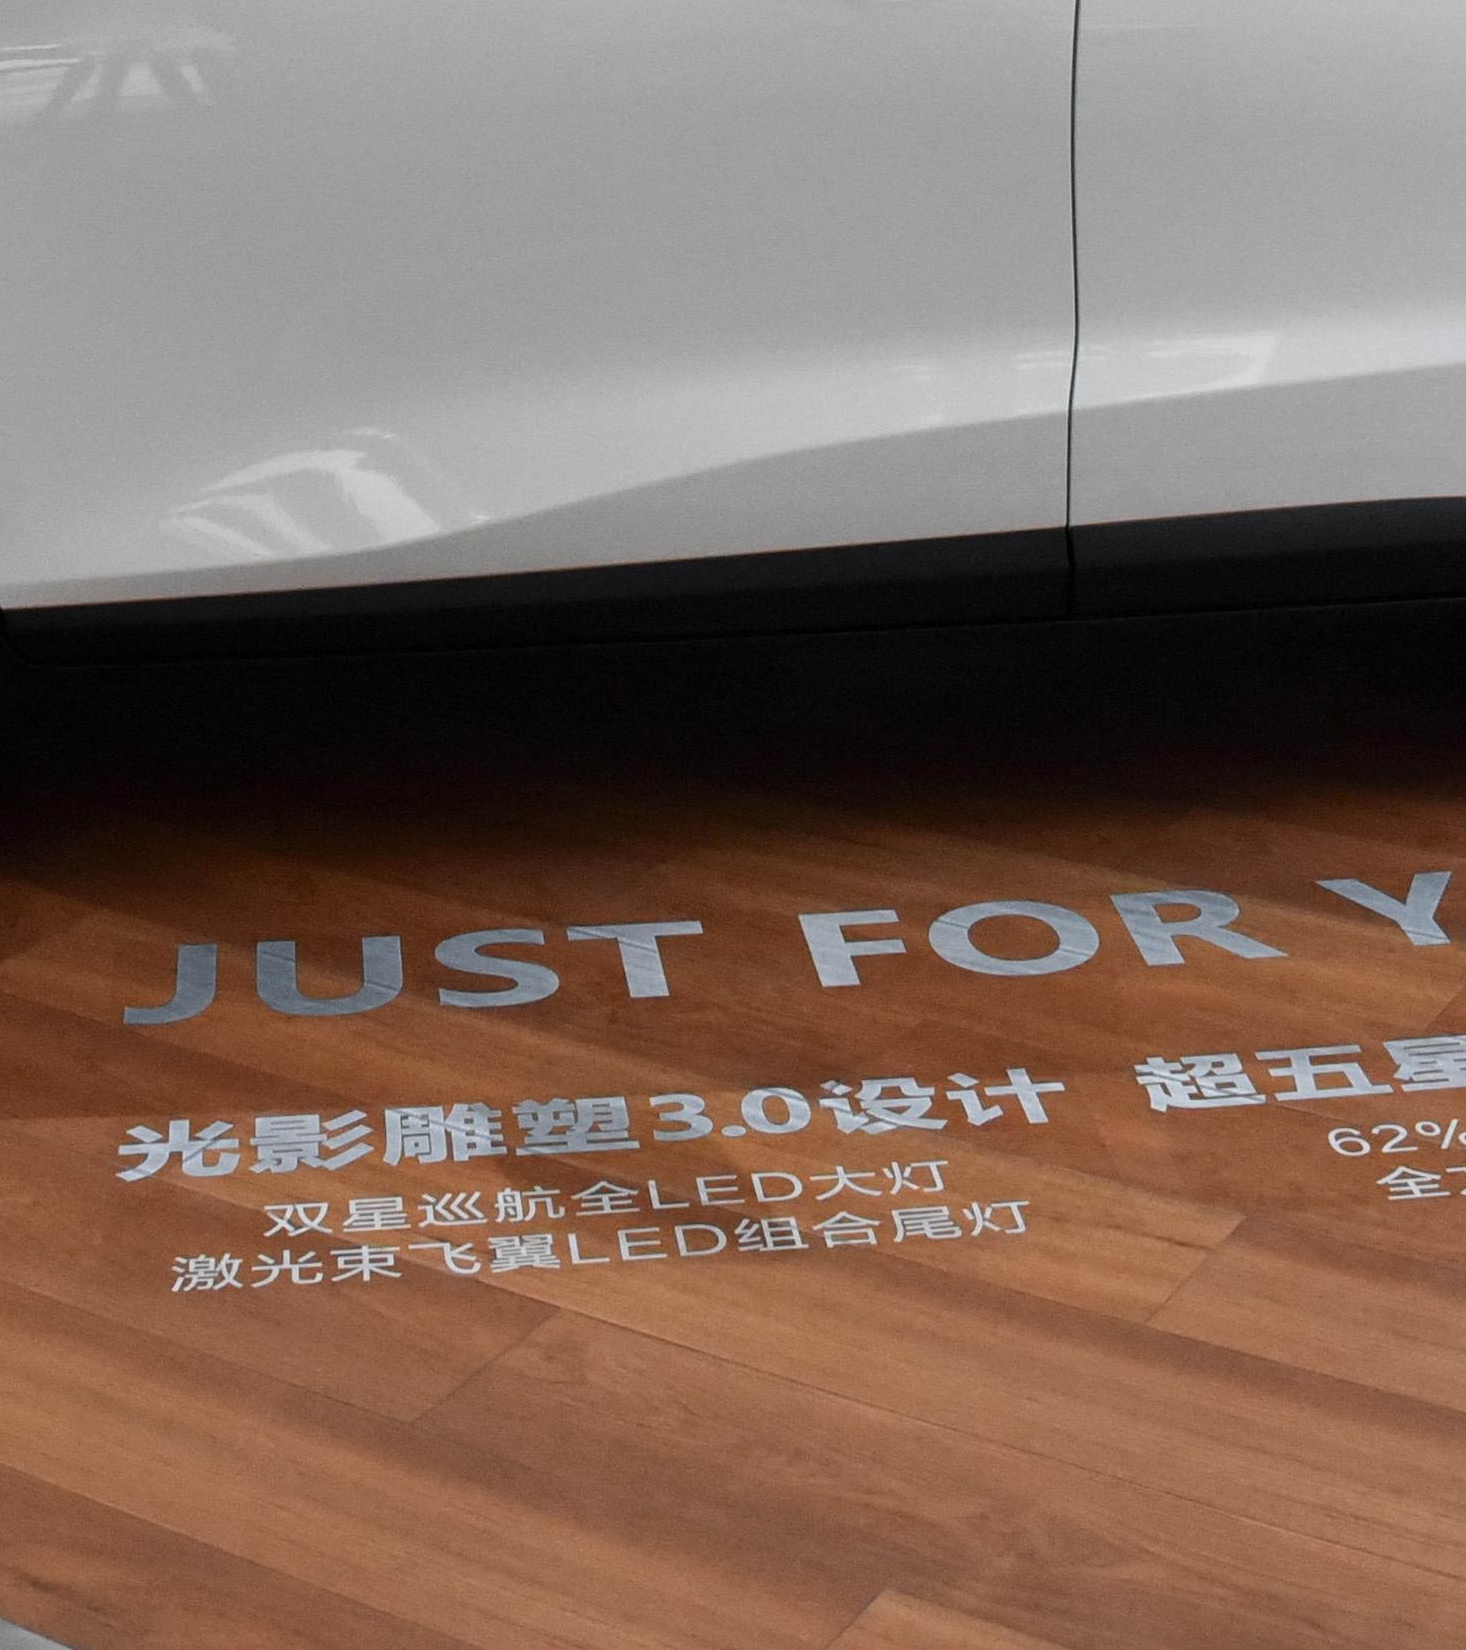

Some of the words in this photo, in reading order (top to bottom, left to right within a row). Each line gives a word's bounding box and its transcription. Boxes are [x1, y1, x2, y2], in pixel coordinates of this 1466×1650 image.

[123, 920, 703, 1025] JUST
[798, 890, 1289, 988] FOR
[118, 1068, 1065, 1181] 光影雕塑3.0设计
[171, 1200, 1031, 1292] 激光束飞翼LED组合尾灯
[263, 1160, 950, 1237] 双星巡航全LED大灯
